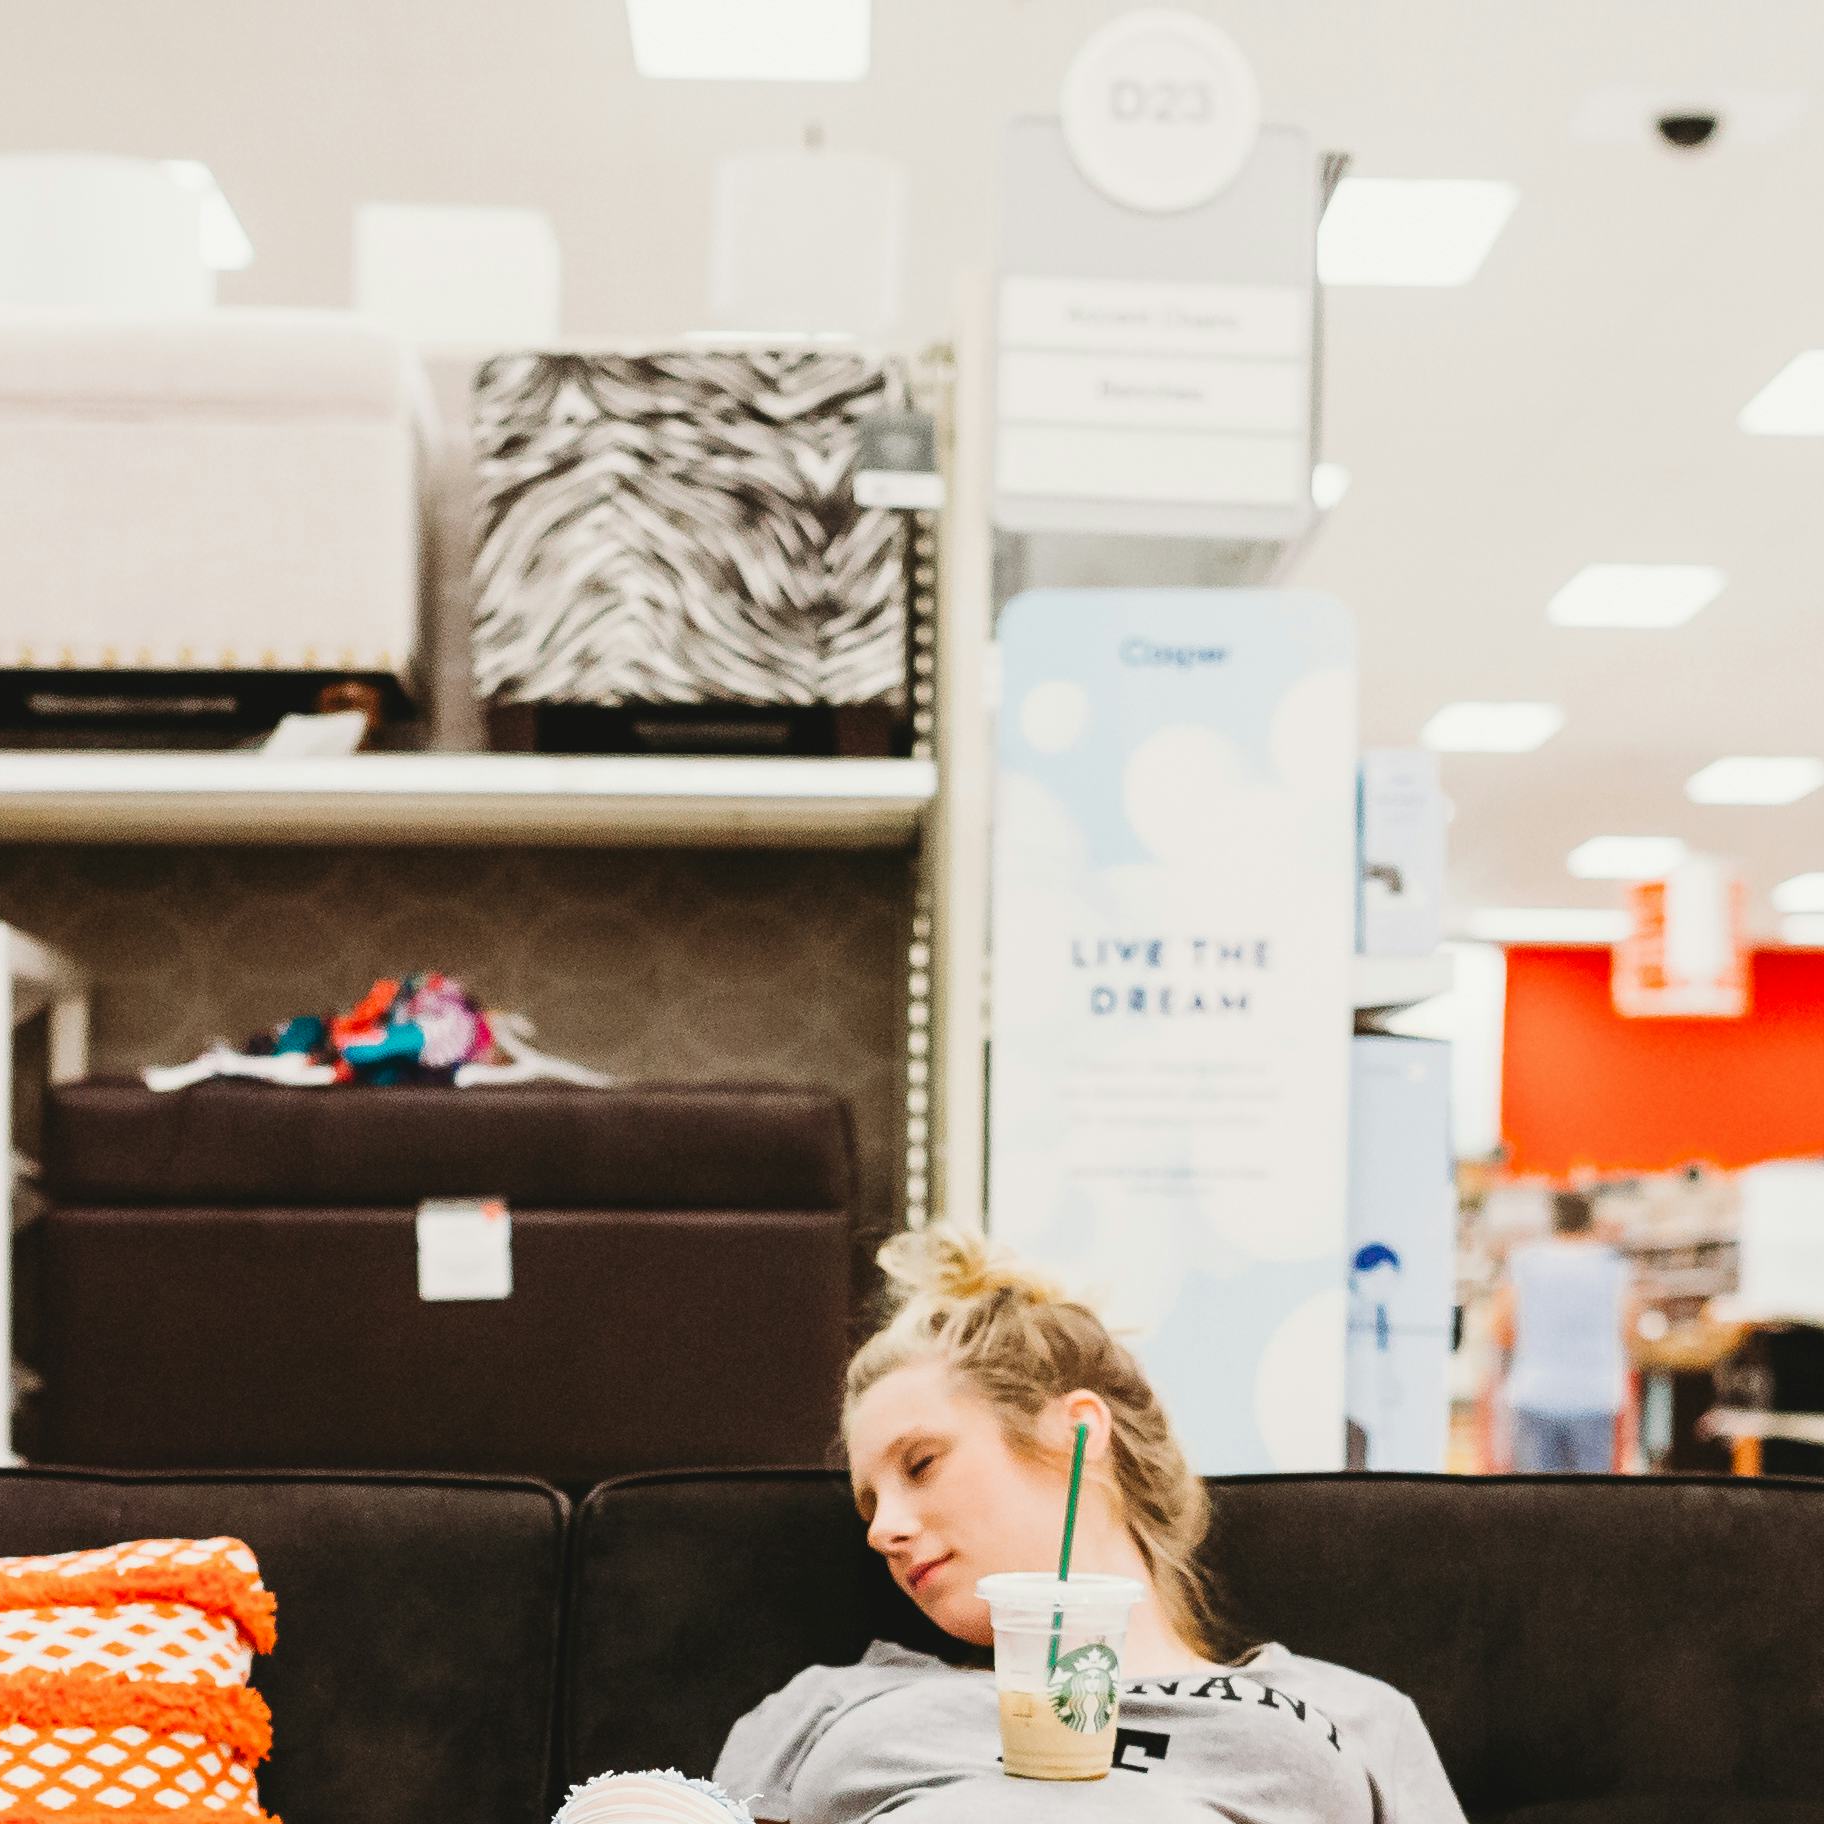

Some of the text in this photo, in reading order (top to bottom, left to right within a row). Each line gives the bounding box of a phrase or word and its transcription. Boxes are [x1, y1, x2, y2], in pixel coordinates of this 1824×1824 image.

[1071, 938, 1271, 971] LIVE THE
[1090, 985, 1250, 1017] DREAM
